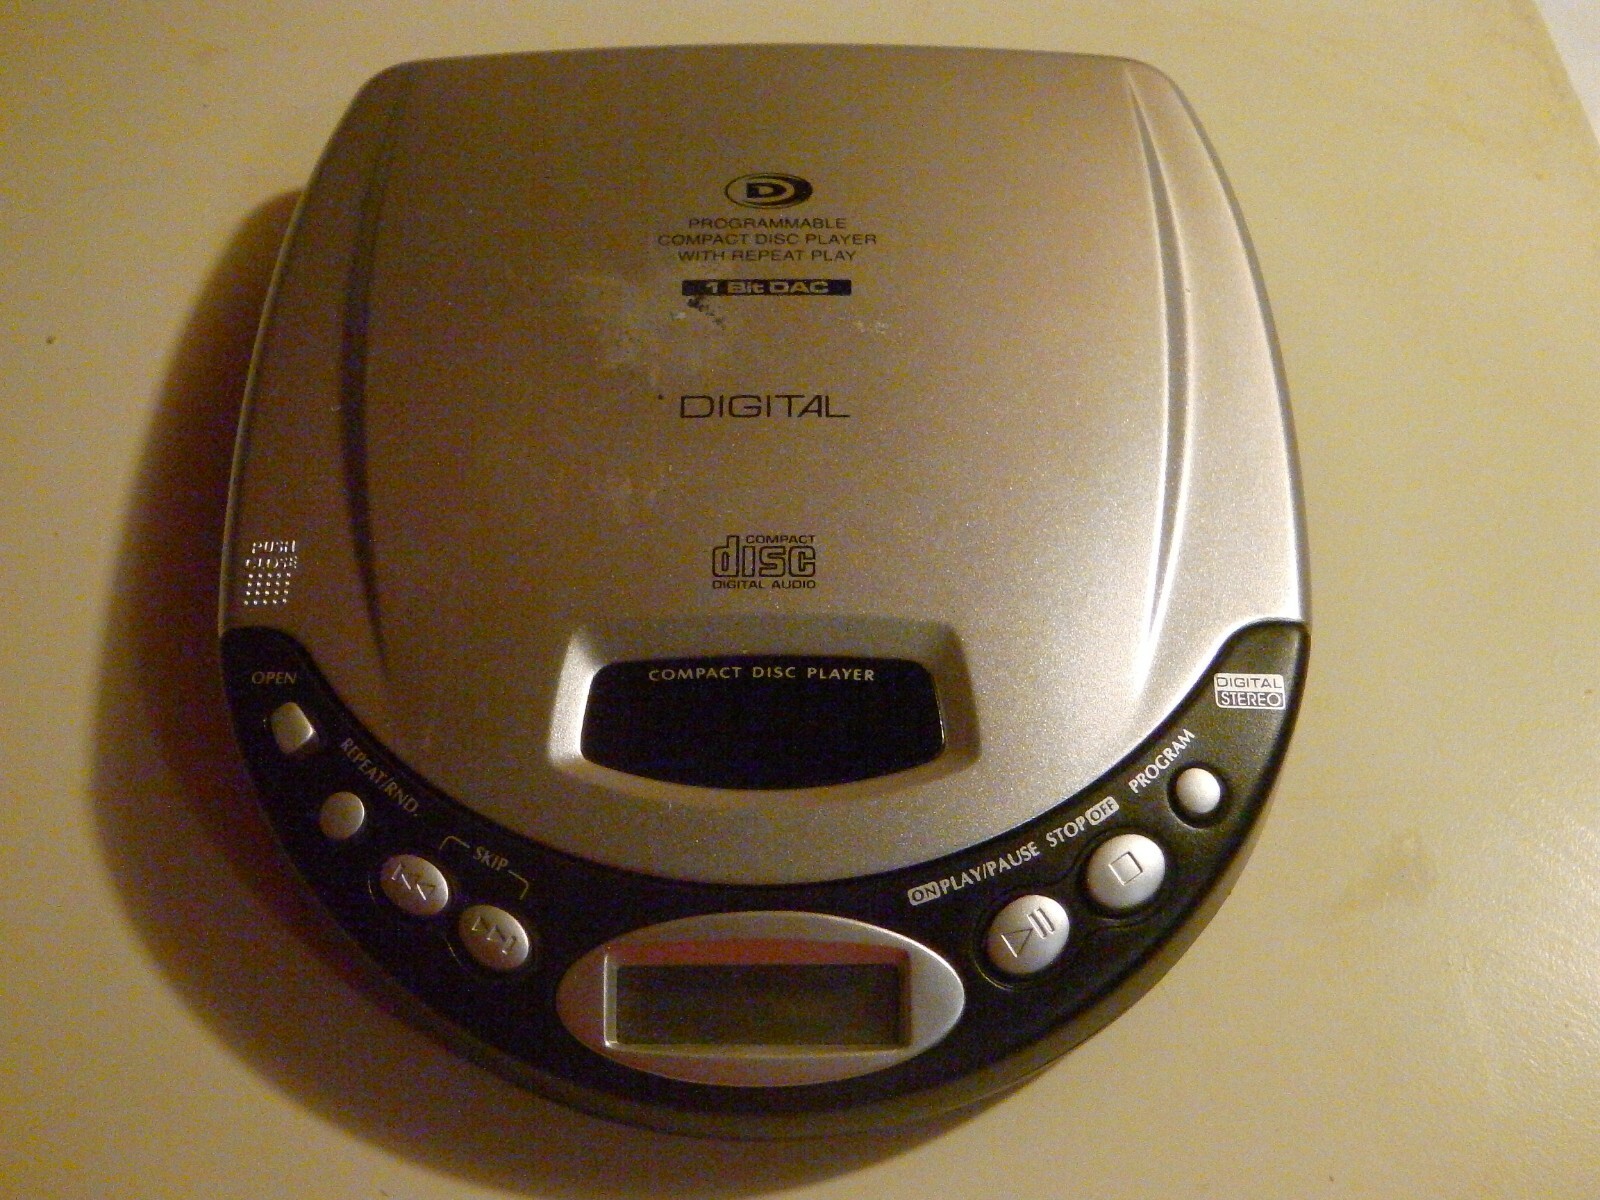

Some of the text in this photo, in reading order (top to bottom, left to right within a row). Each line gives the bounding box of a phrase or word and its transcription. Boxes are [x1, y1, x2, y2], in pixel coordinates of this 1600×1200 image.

[688, 217, 847, 229] PROGRAMMABLE
[657, 233, 877, 246] COMPACT DISC PLAYER
[678, 250, 857, 262] WITH REPEAT PLAY
[705, 281, 719, 294] 1
[769, 281, 829, 294] DAC
[680, 394, 850, 419] DIGITAL
[745, 534, 816, 544] COMPACT
[712, 535, 816, 578] disc
[712, 579, 816, 589] DIGITAL AUDIO
[251, 671, 298, 685] OPEN
[649, 666, 876, 682] COMPACT DISC PLAYER
[1216, 676, 1283, 689] DIGITAL
[1220, 691, 1281, 707] STEREO
[1128, 728, 1196, 794] PROGRAM
[1045, 799, 1116, 848] STOP OFF
[473, 846, 509, 872] SKIP
[911, 841, 1041, 903] ON PLAY/PAUSE
